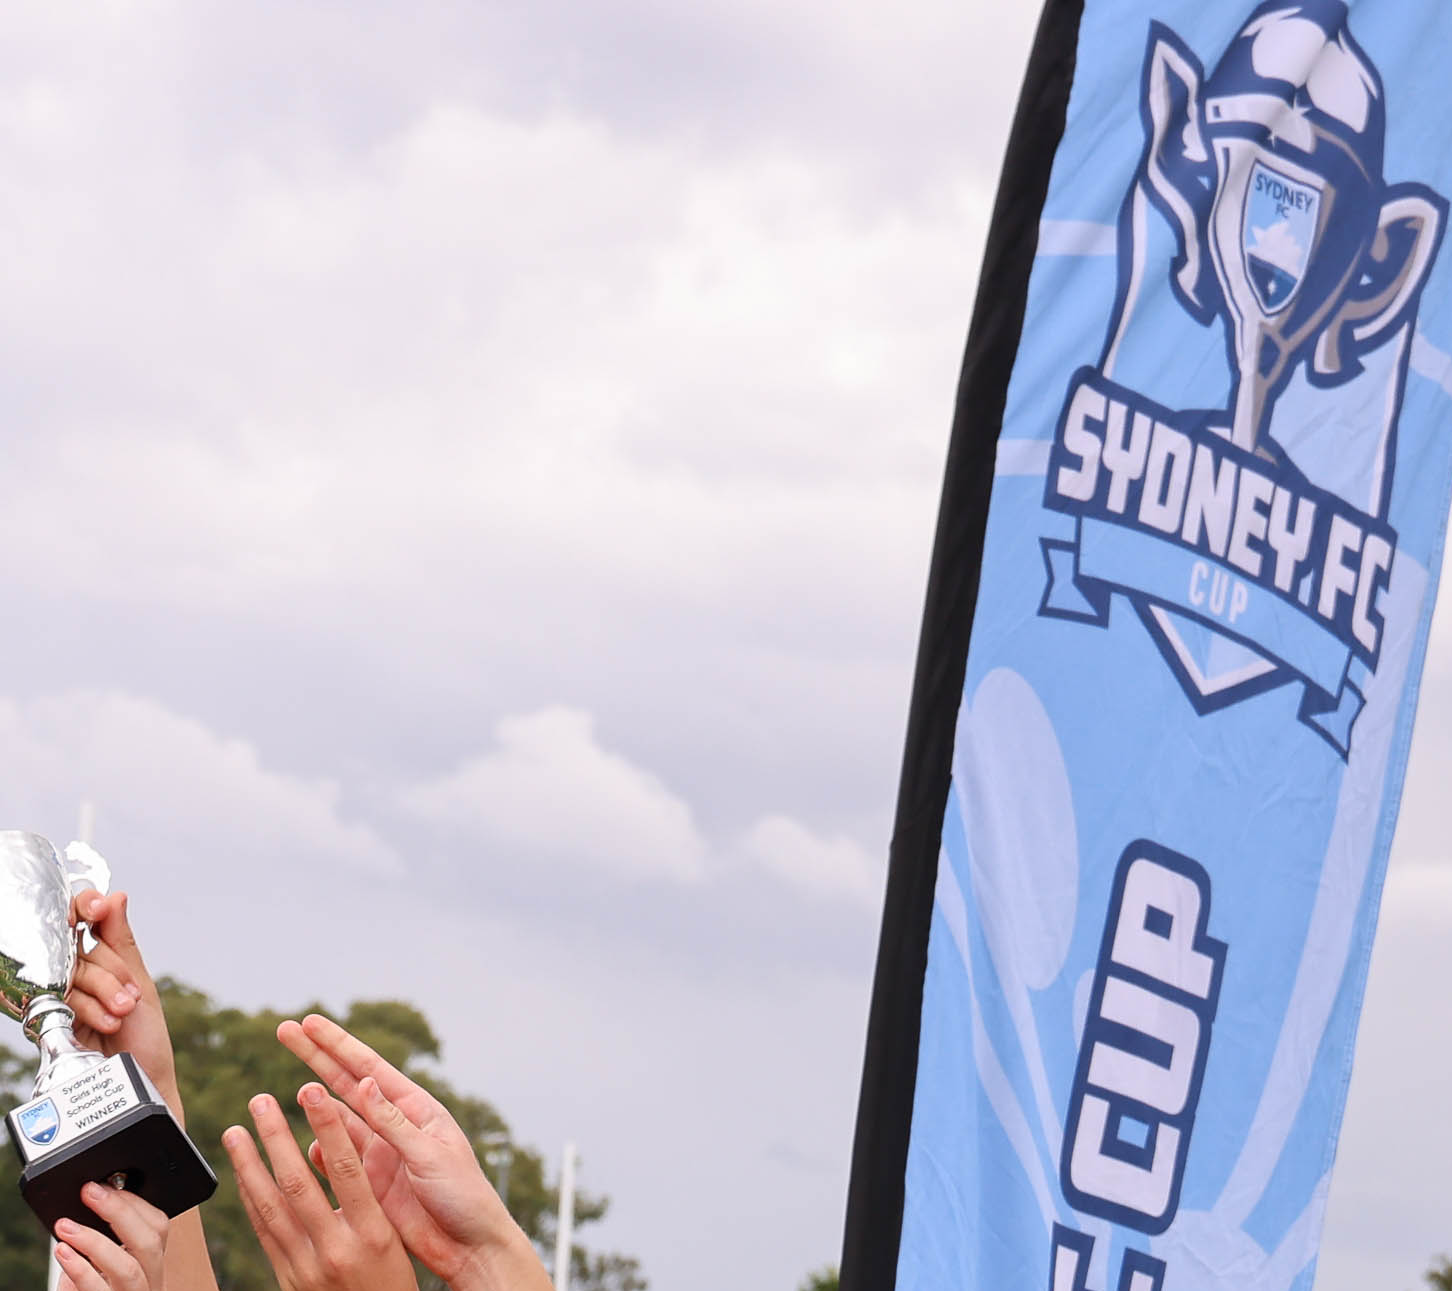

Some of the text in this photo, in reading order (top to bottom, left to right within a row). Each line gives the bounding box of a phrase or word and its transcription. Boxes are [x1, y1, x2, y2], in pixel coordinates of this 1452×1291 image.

[1256, 173, 1313, 214] SYDNEY
[1276, 204, 1289, 219] FC
[1056, 383, 1393, 654] SYDNEY FC
[1187, 560, 1249, 624] CUP
[1063, 842, 1225, 1232] CUP
[62, 1064, 112, 1096] Sydney FC
[92, 1077, 113, 1093] High
[67, 1083, 124, 1118] Schools Cup
[75, 1097, 127, 1129] WINNERS
